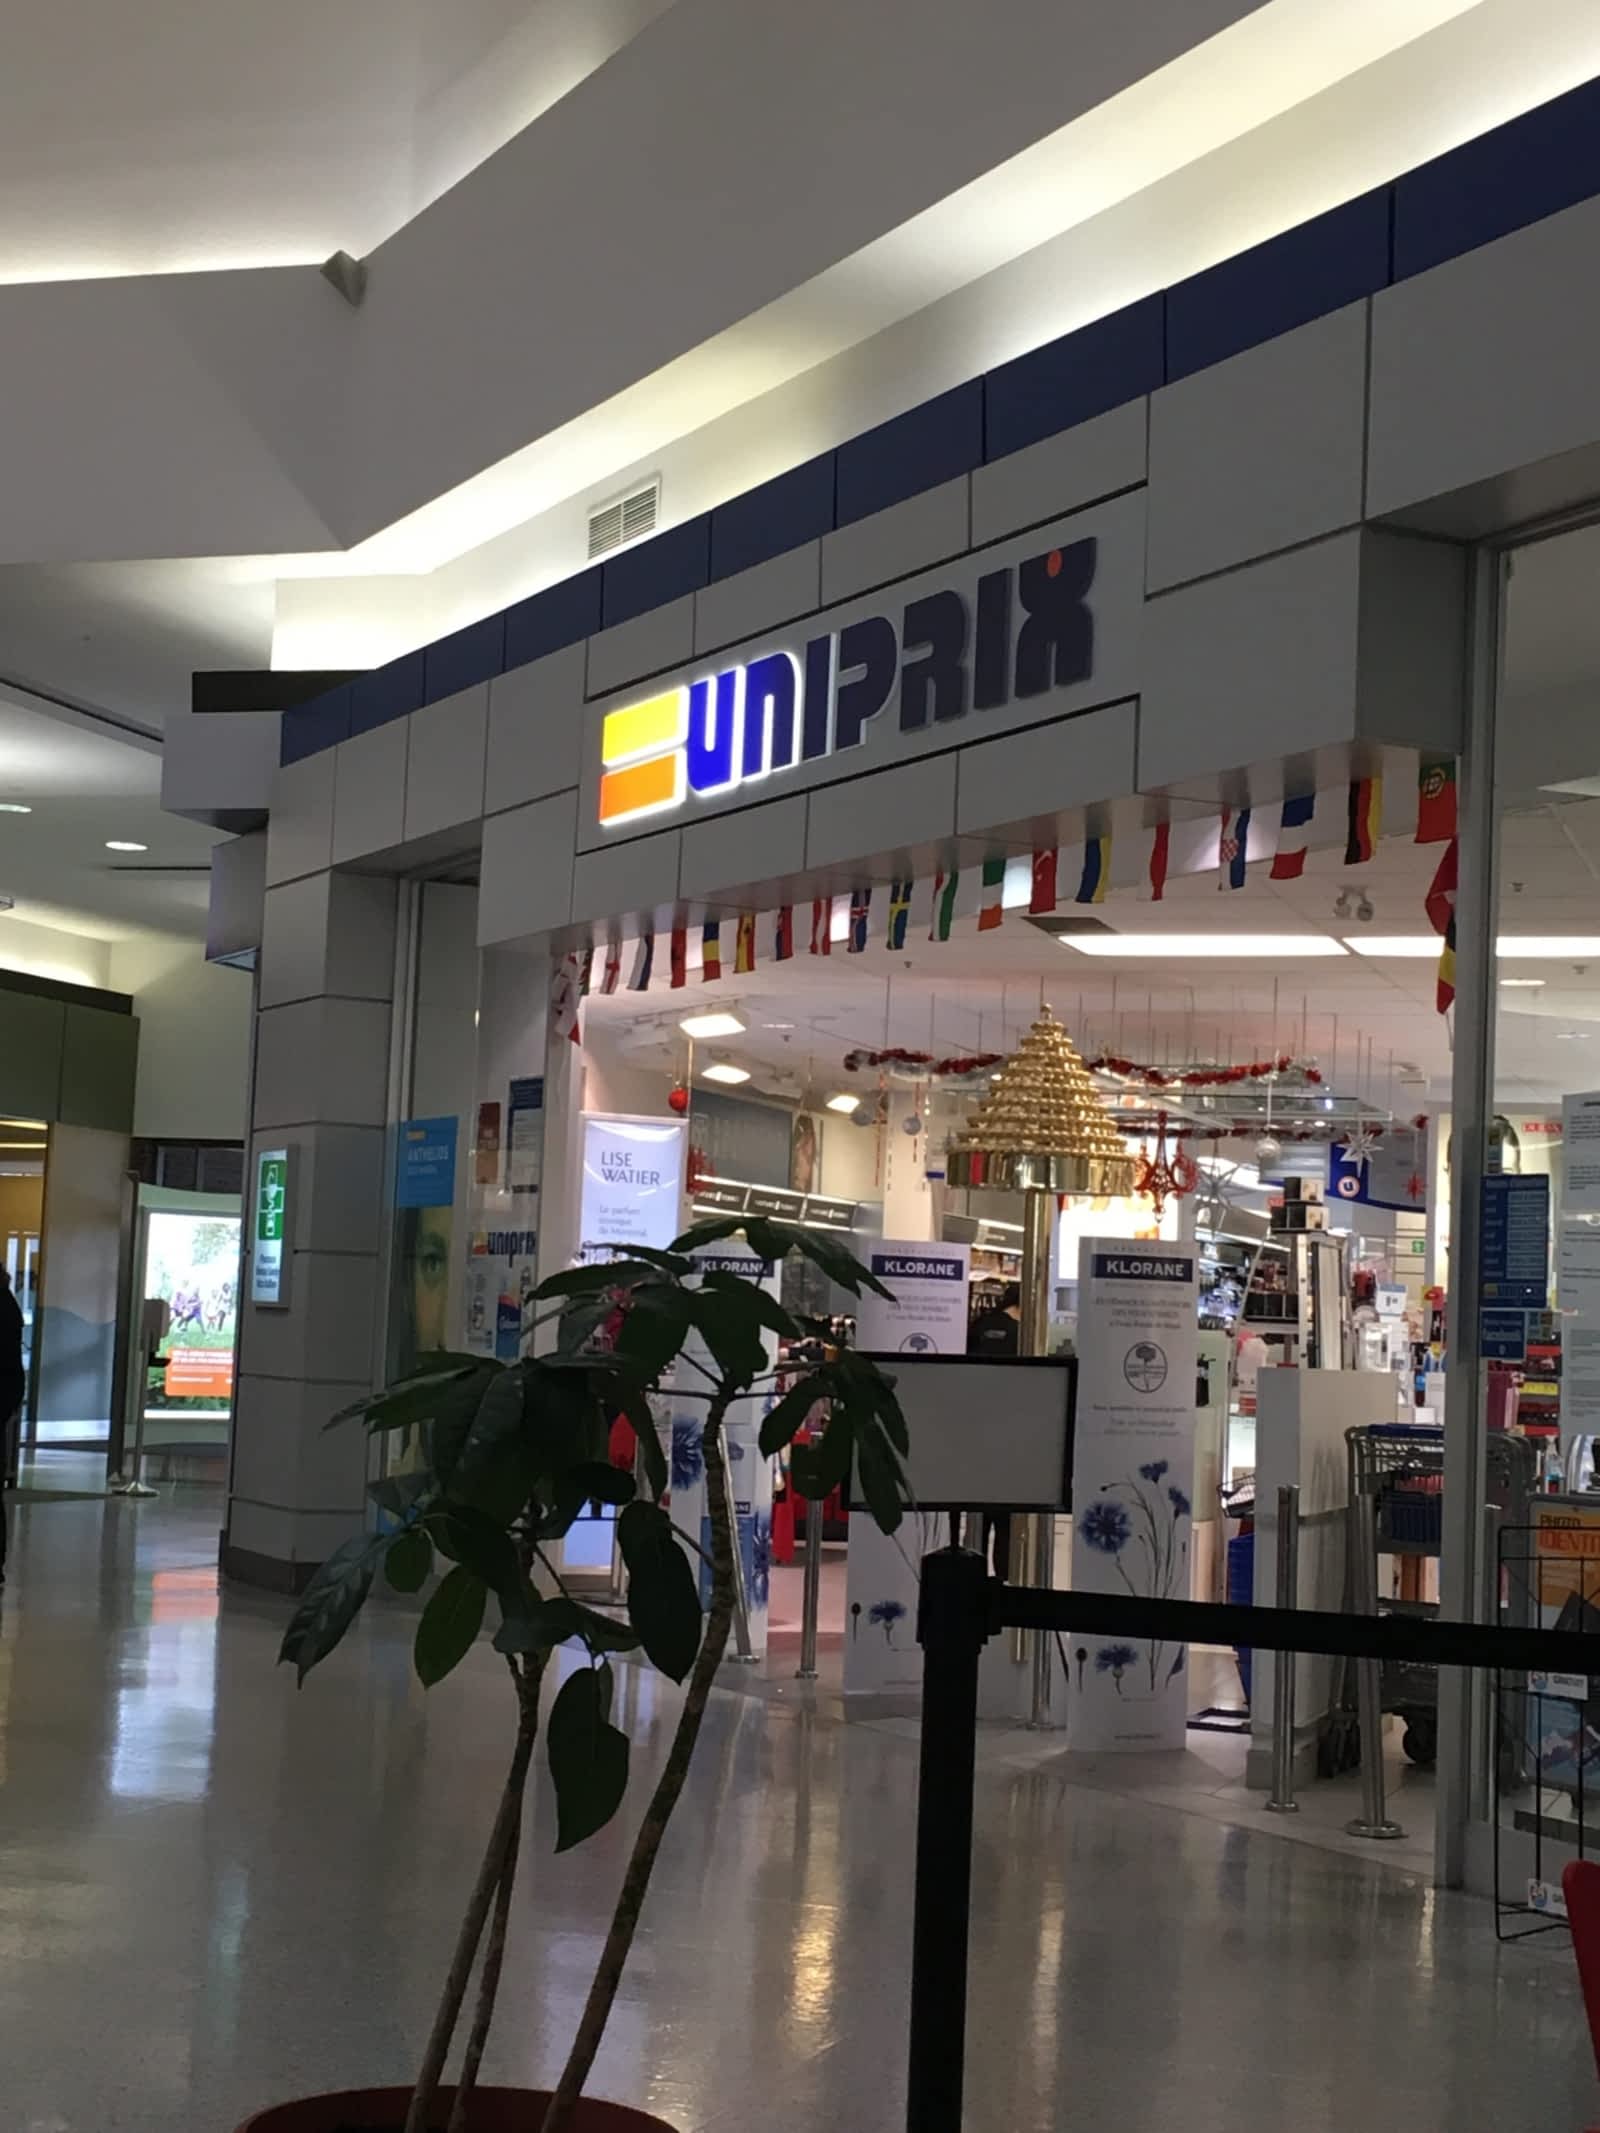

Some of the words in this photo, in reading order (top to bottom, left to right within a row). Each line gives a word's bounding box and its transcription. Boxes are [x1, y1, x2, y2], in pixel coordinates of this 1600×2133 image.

[686, 536, 1097, 797] UNIPRIX
[601, 1151, 632, 1167] LISE
[601, 1168, 661, 1185] WATIER
[884, 1260, 956, 1276] KLORANE
[1106, 1260, 1184, 1277] KLORANE
